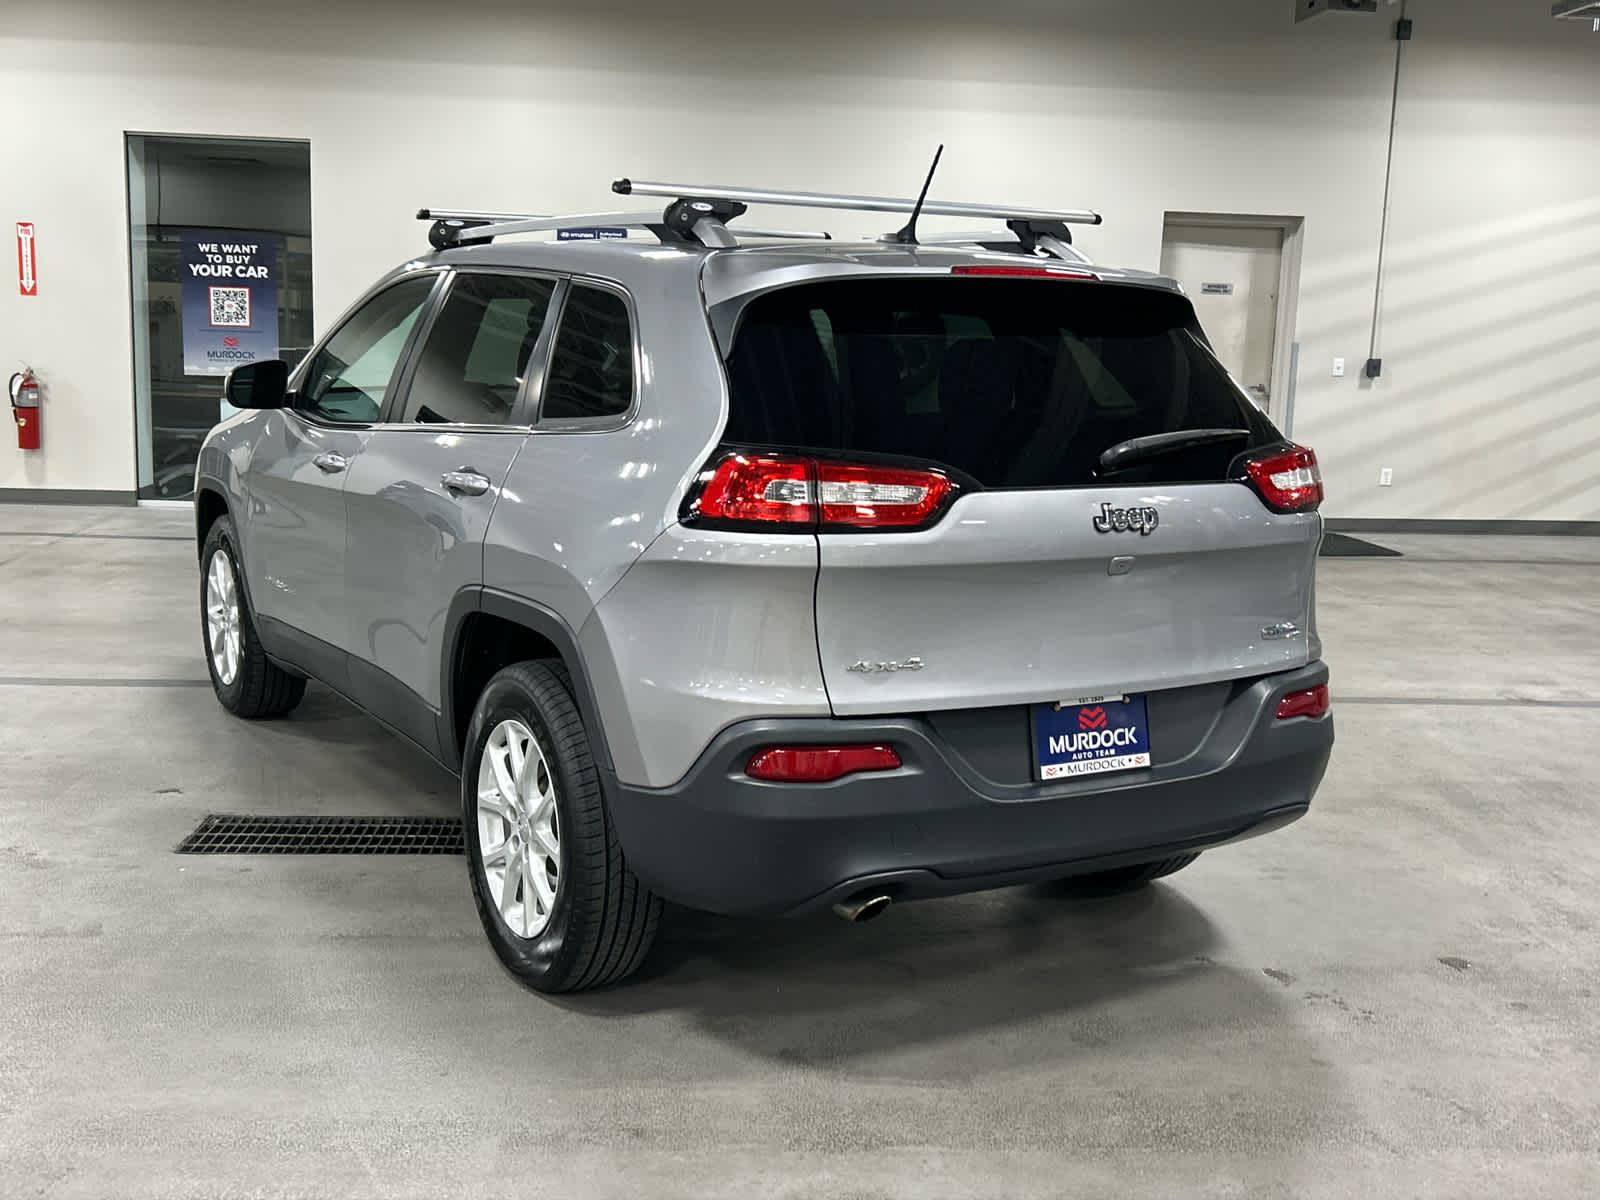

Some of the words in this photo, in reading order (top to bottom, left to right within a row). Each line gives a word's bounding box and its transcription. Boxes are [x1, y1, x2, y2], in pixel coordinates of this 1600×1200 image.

[198, 243, 218, 252] WE
[221, 244, 258, 254] WANT
[206, 254, 222, 263] TO
[226, 255, 250, 264] BUY
[189, 264, 232, 277] YOUR
[235, 265, 268, 278] CAR
[207, 350, 255, 359] MURDOCK
[1093, 502, 1159, 536] Jeep
[1049, 726, 1138, 754] MURDOCK
[1072, 751, 1093, 760] AUTO
[1095, 748, 1116, 758] TEAM
[1067, 757, 1126, 774] MURDOCK
